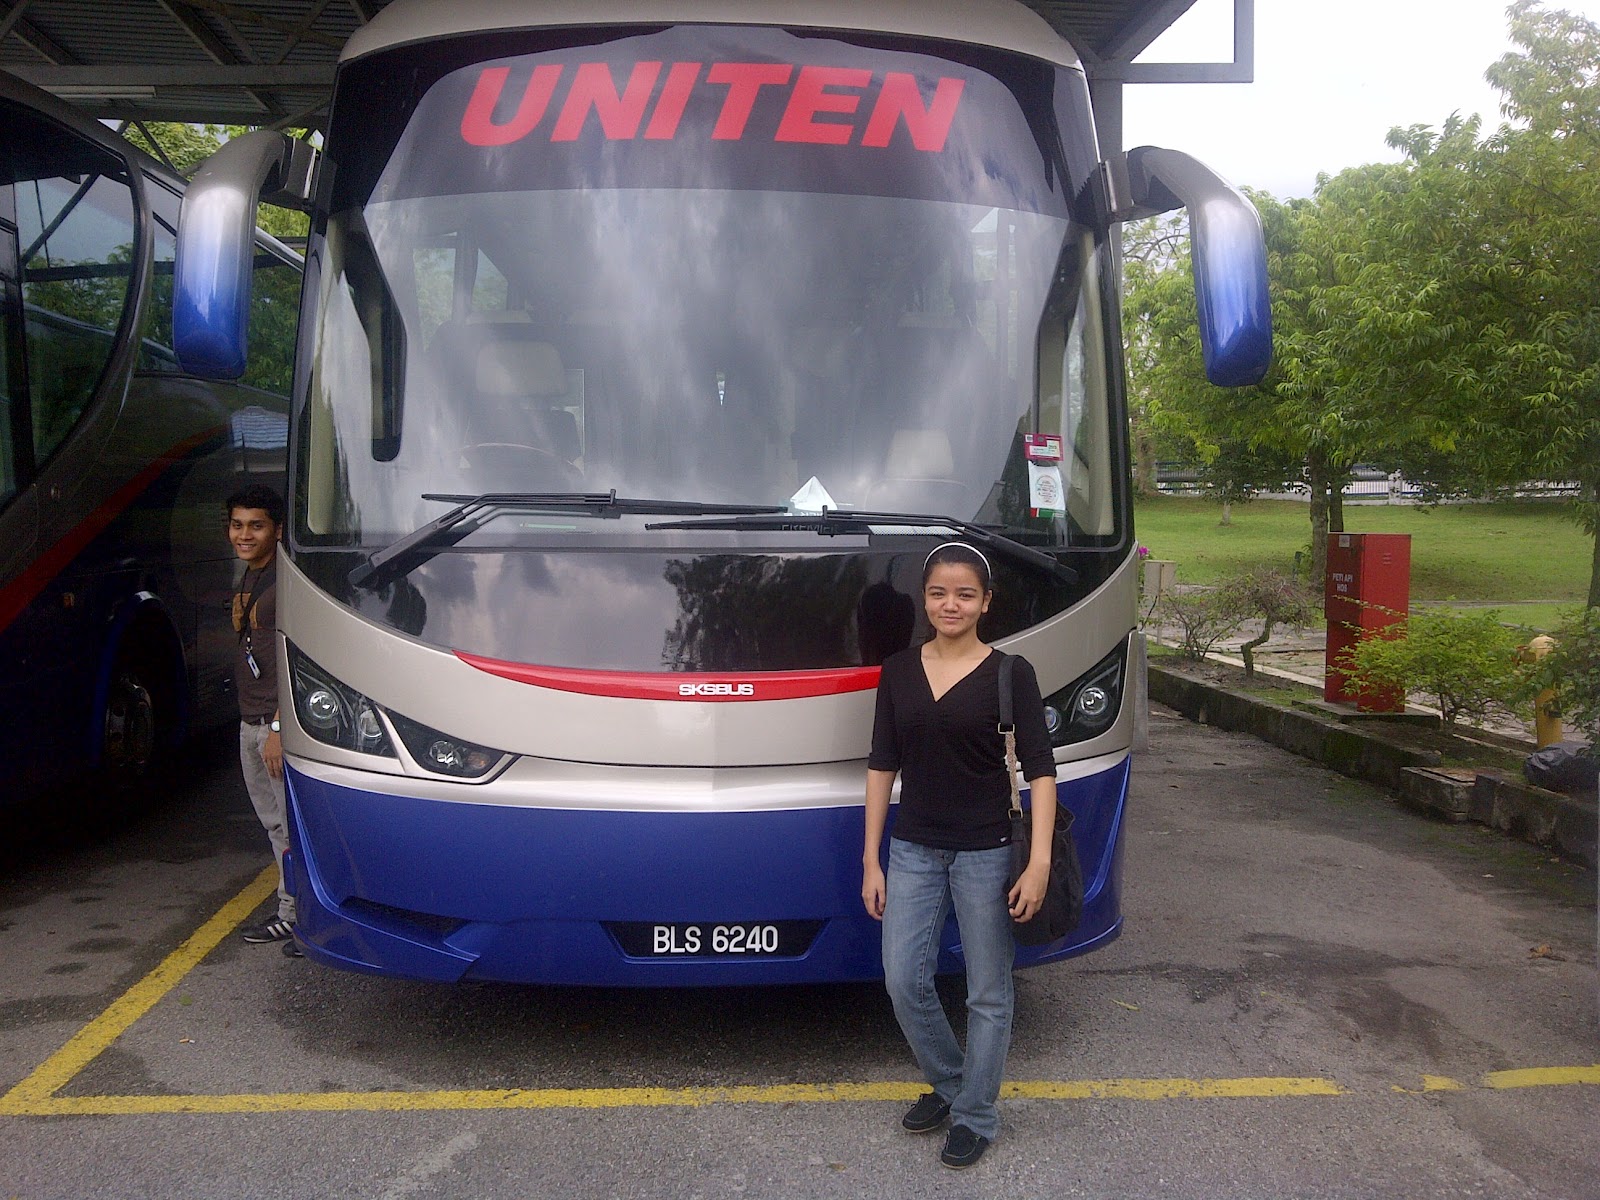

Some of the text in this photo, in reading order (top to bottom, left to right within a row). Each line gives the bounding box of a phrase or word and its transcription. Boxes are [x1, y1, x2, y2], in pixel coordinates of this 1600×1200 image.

[460, 61, 965, 153] UNITEN
[678, 683, 755, 696] SKSBUS
[653, 925, 779, 953] BLS 6240
